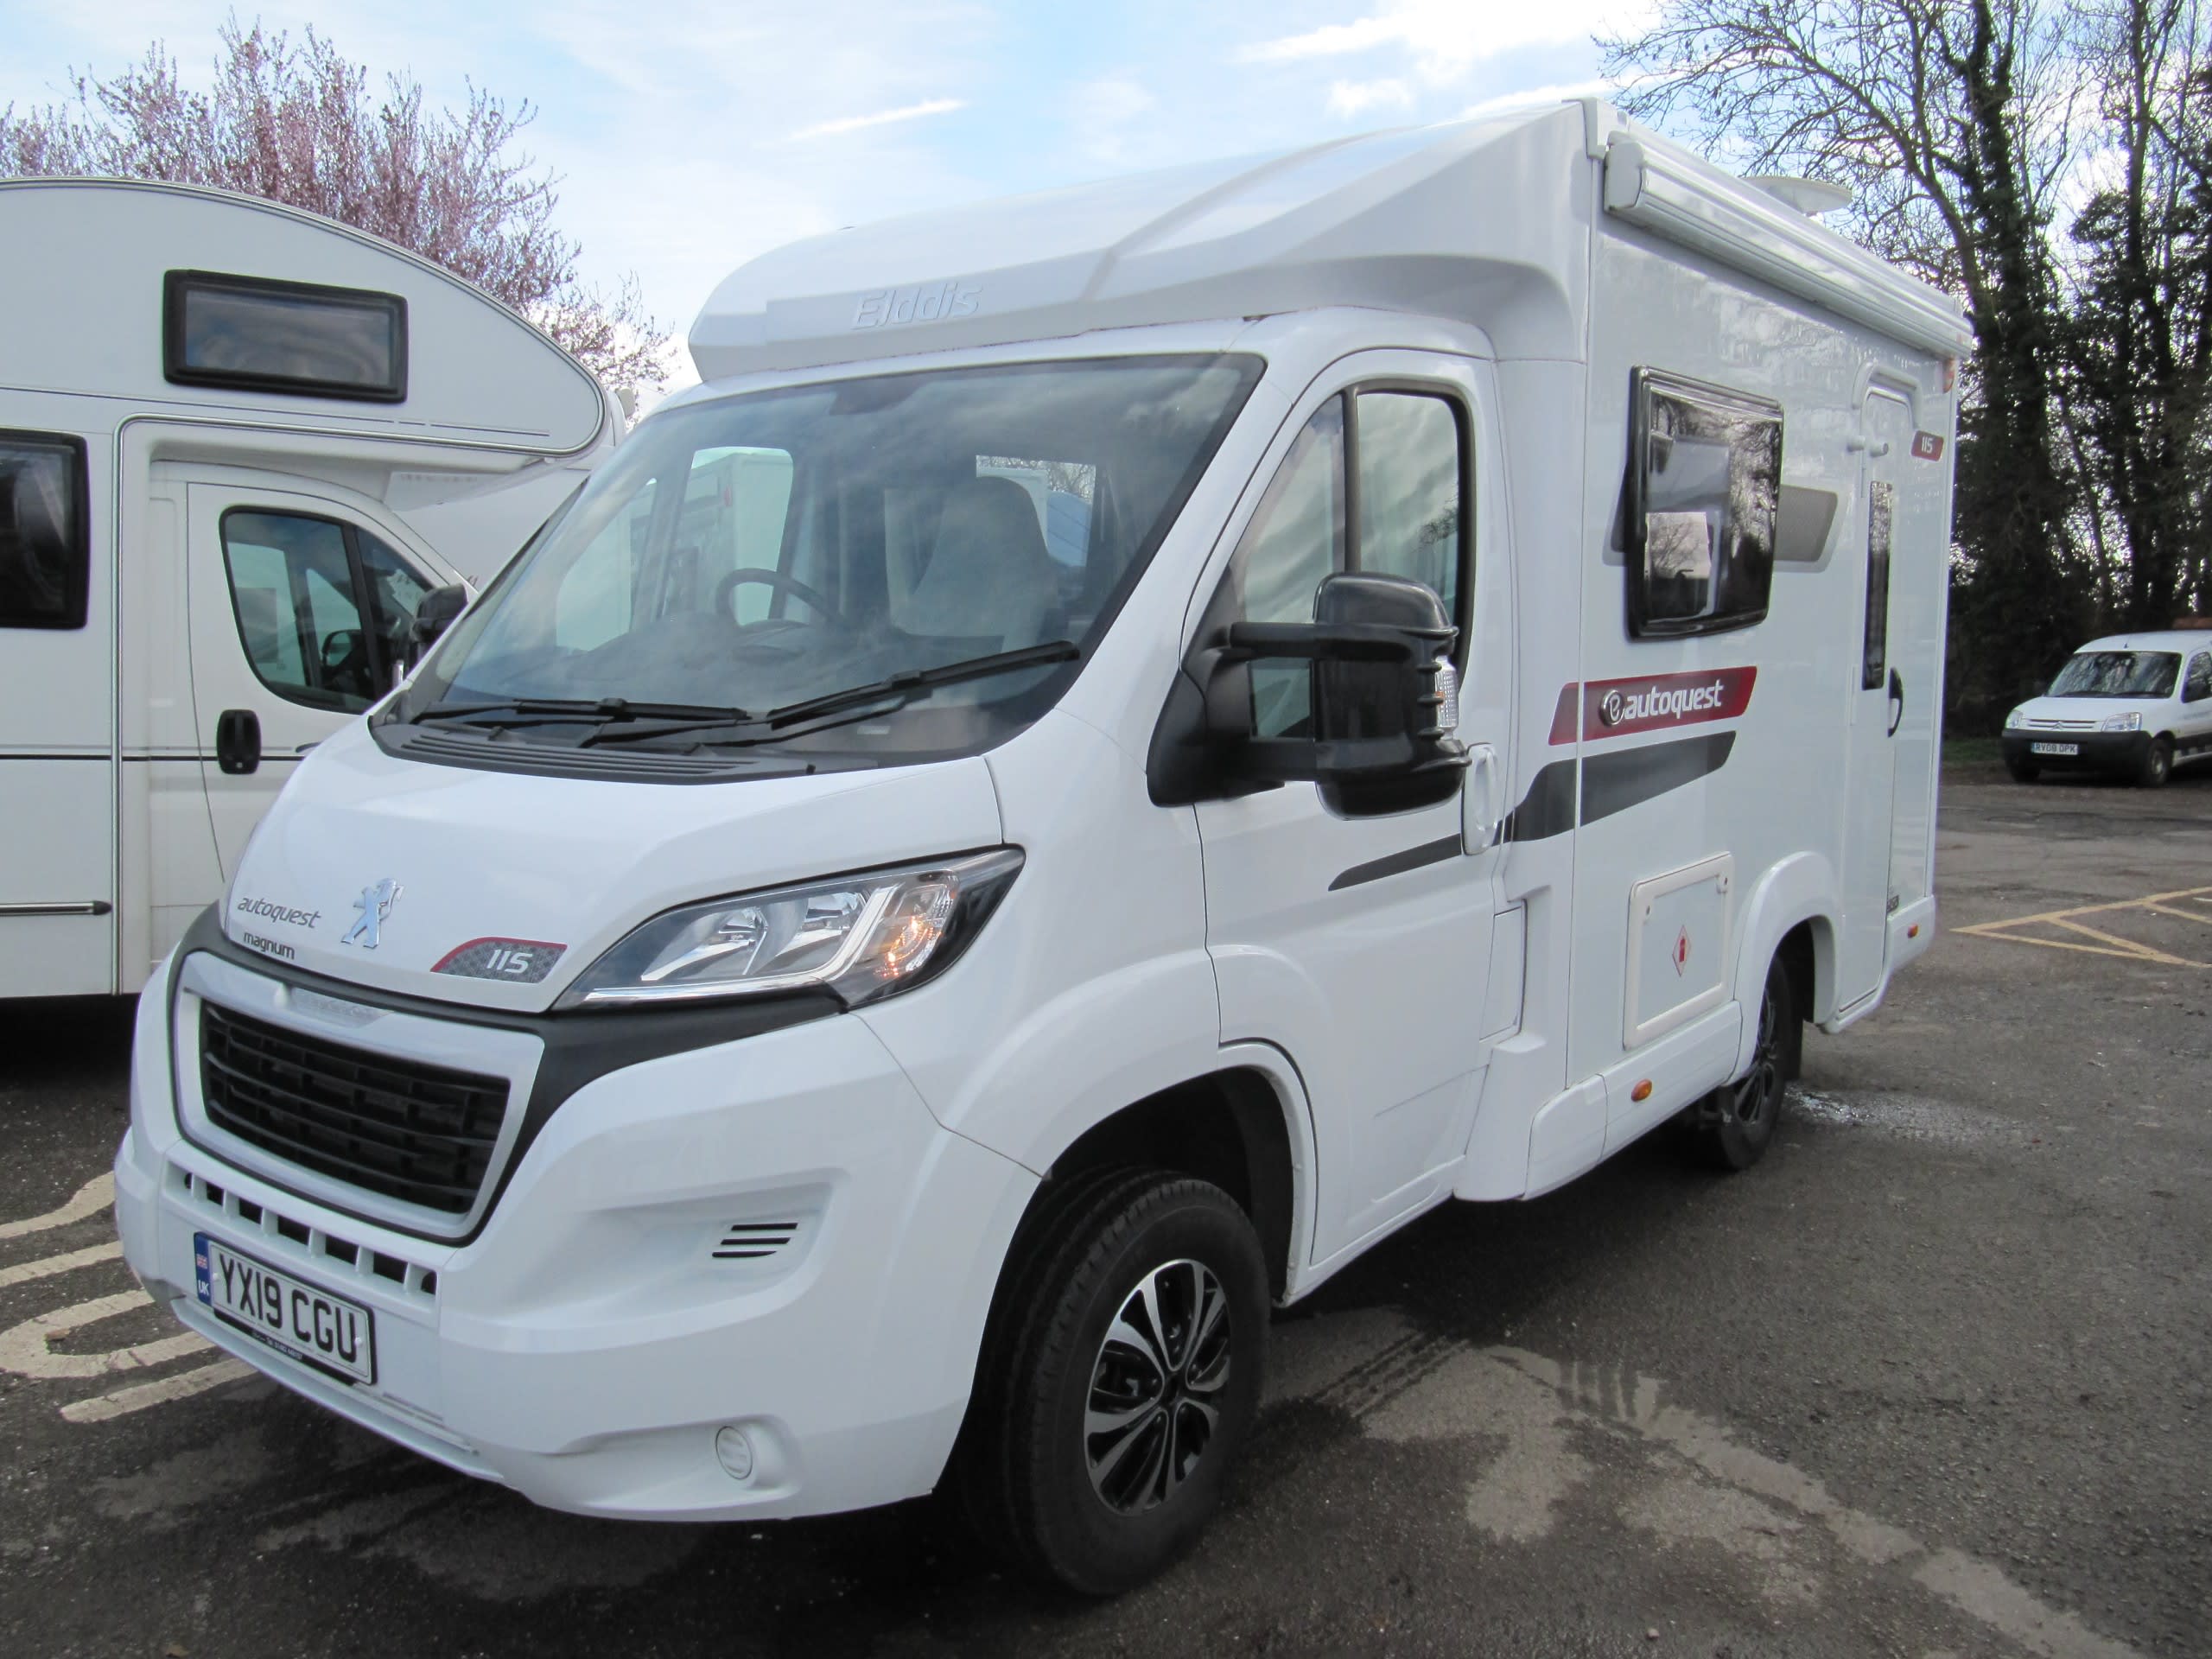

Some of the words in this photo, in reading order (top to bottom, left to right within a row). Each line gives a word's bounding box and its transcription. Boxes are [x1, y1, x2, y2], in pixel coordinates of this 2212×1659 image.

[851, 283, 983, 330] Elddis
[1921, 435, 1934, 454] 115
[1624, 678, 1725, 720] autoquest
[237, 897, 322, 929] autoquest
[243, 931, 296, 961] magnum
[486, 949, 533, 975] 115
[197, 1279, 210, 1296] UK
[219, 1253, 283, 1330] YX19
[291, 1288, 357, 1363] CGU
